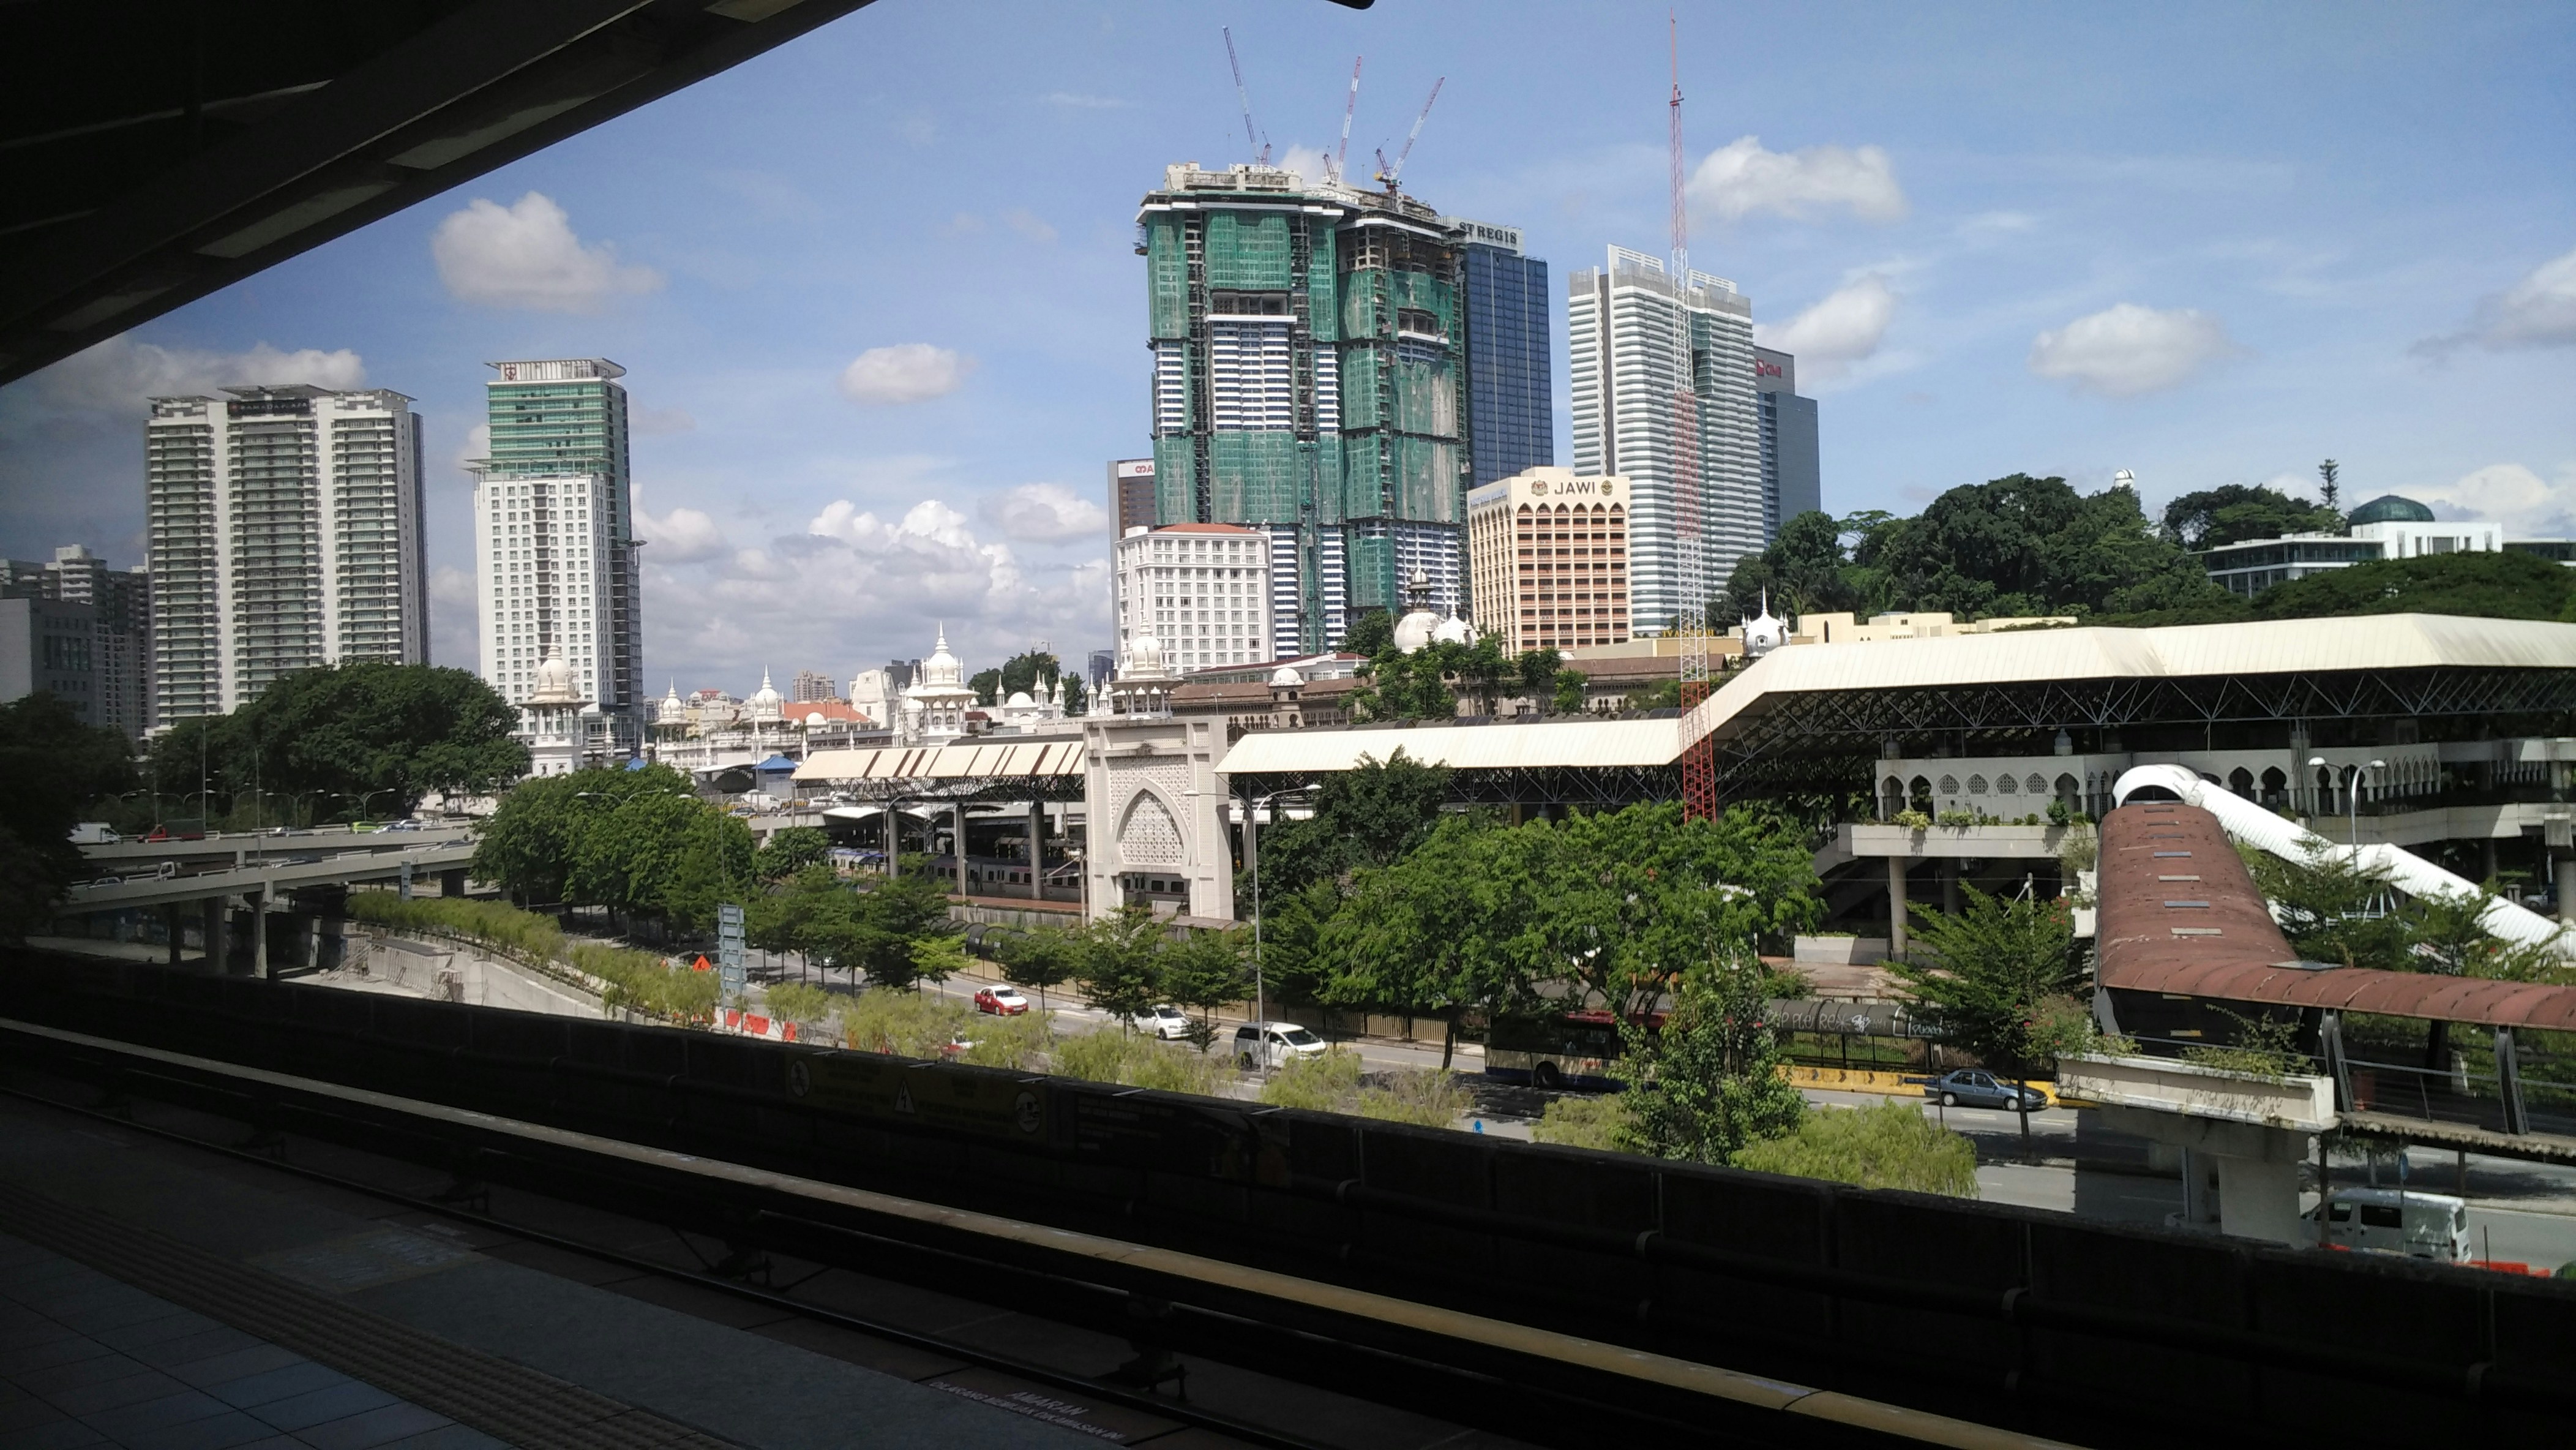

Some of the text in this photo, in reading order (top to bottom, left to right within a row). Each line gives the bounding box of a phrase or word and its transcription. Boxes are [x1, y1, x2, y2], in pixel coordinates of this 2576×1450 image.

[1477, 225, 1517, 244] REGIS
[1554, 481, 1595, 495] JAWI
[1005, 1391, 1090, 1416] AMARAN
